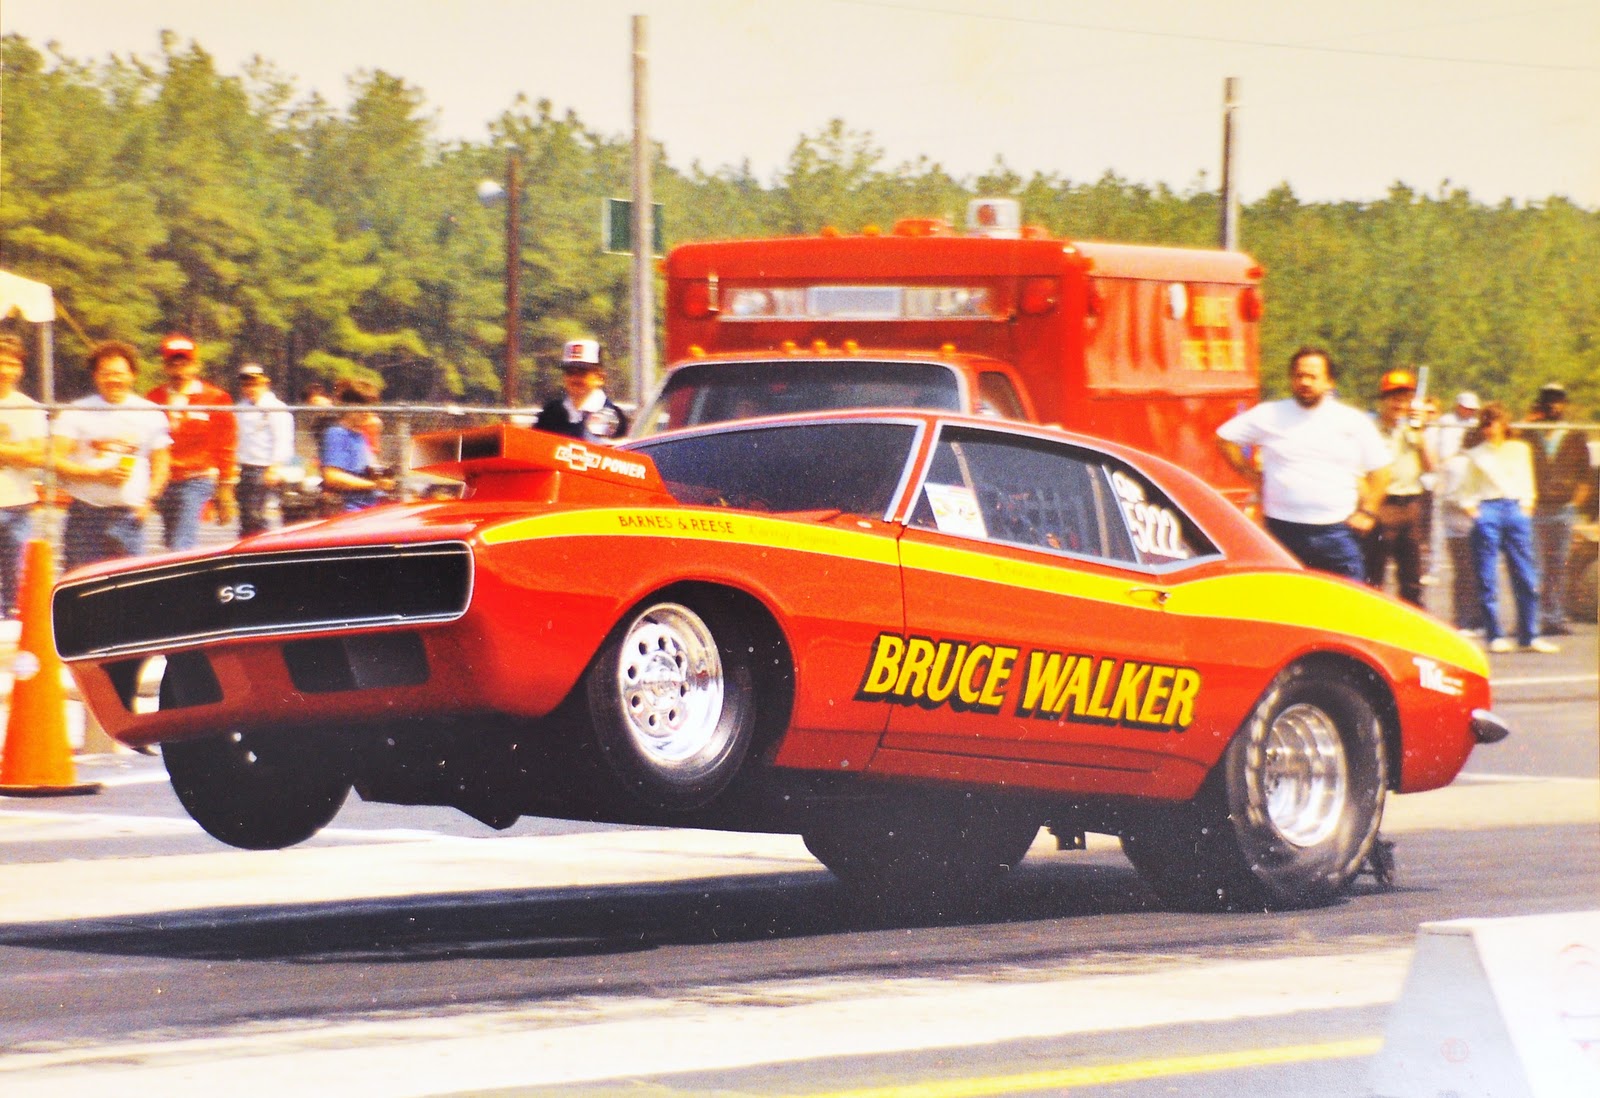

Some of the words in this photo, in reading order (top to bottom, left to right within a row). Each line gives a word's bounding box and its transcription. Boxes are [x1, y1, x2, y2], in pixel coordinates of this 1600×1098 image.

[601, 457, 646, 479] POWER
[618, 515, 673, 529] BARNES
[678, 517, 688, 530] &
[692, 518, 735, 534] REESE
[219, 583, 256, 603] SS
[857, 632, 1020, 711] BRUCE
[1017, 650, 1200, 730] WALKER
